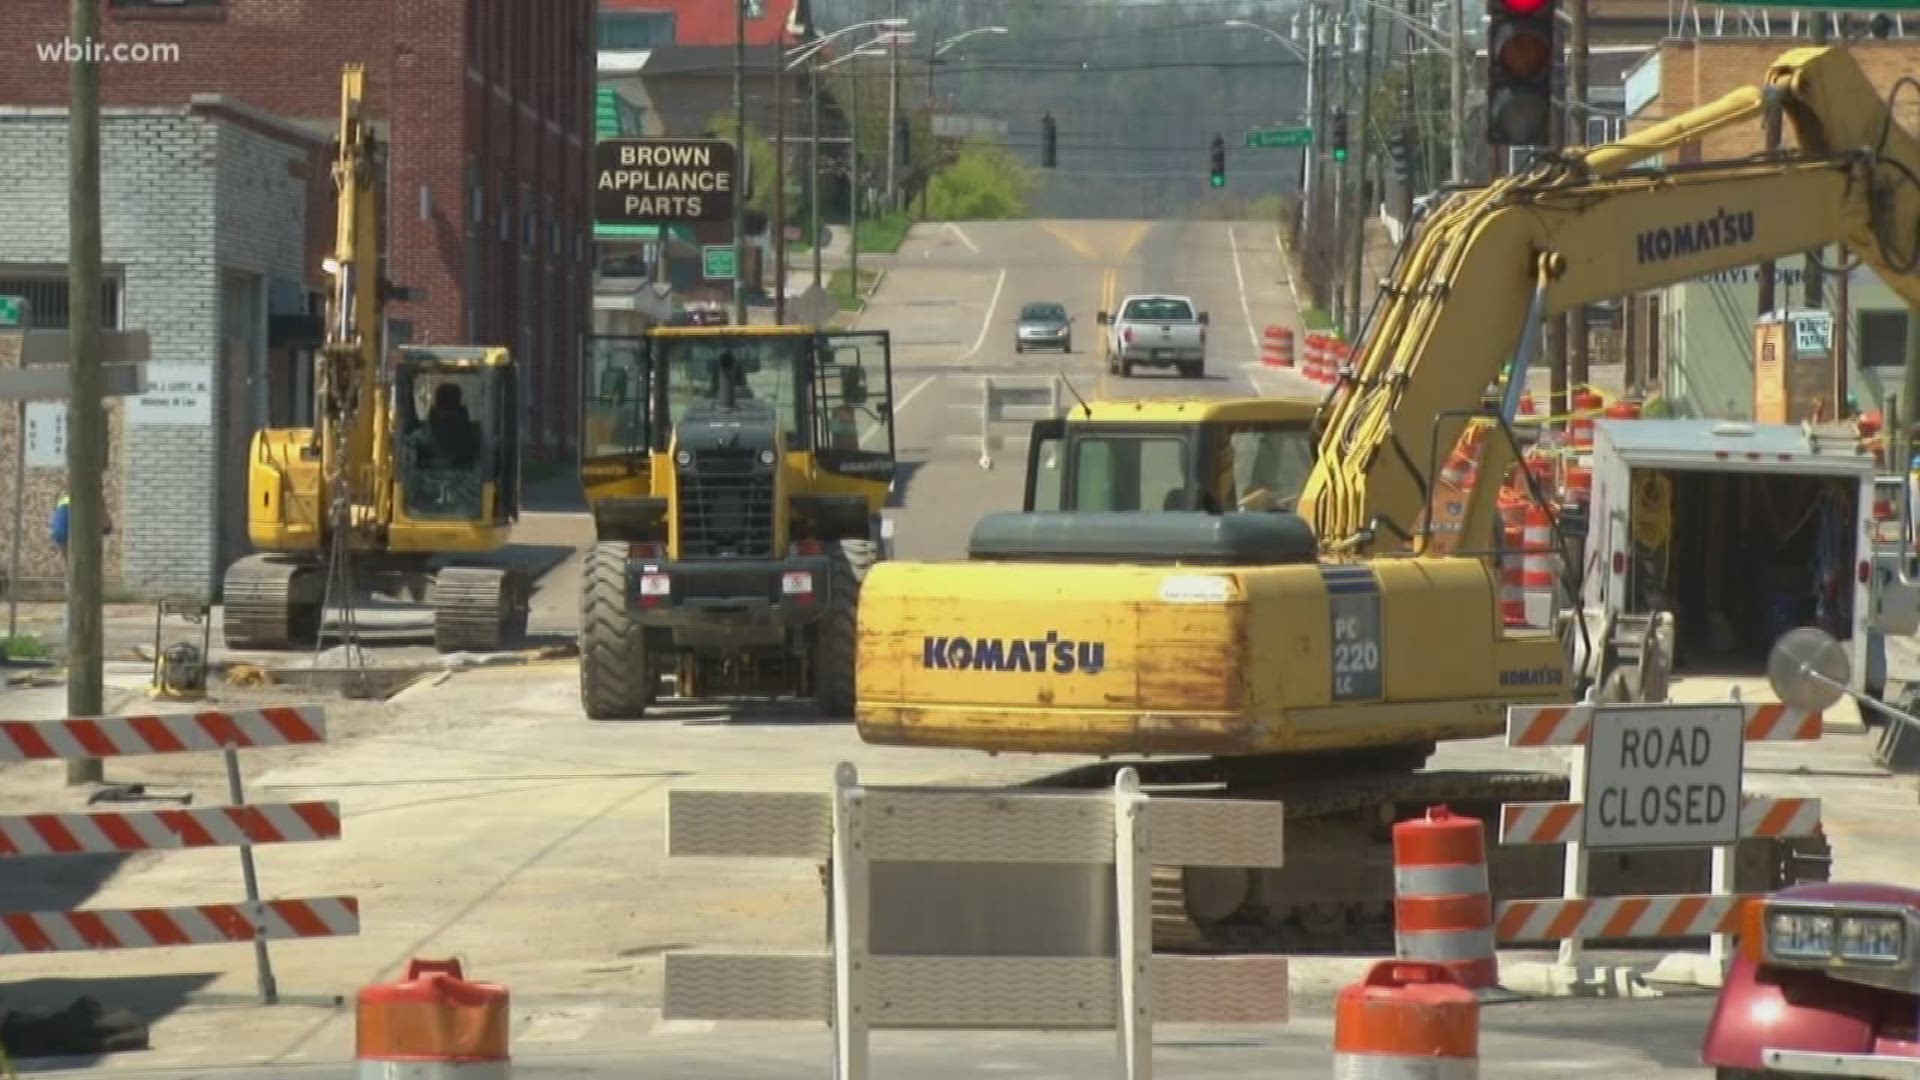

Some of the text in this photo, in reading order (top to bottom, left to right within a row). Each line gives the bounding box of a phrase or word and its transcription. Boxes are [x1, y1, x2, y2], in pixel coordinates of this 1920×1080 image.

[620, 145, 711, 167] BROWN
[598, 171, 730, 192] APPLIANCE
[625, 195, 702, 217] PARTS
[1637, 206, 1754, 264] KOMATSU
[1335, 618, 1358, 640] PC
[923, 630, 1105, 674] KOMATSU
[1335, 641, 1379, 672] 220
[1335, 676, 1353, 696] LC
[1620, 726, 1711, 769] ROAD
[1598, 783, 1726, 828] CLOSED
